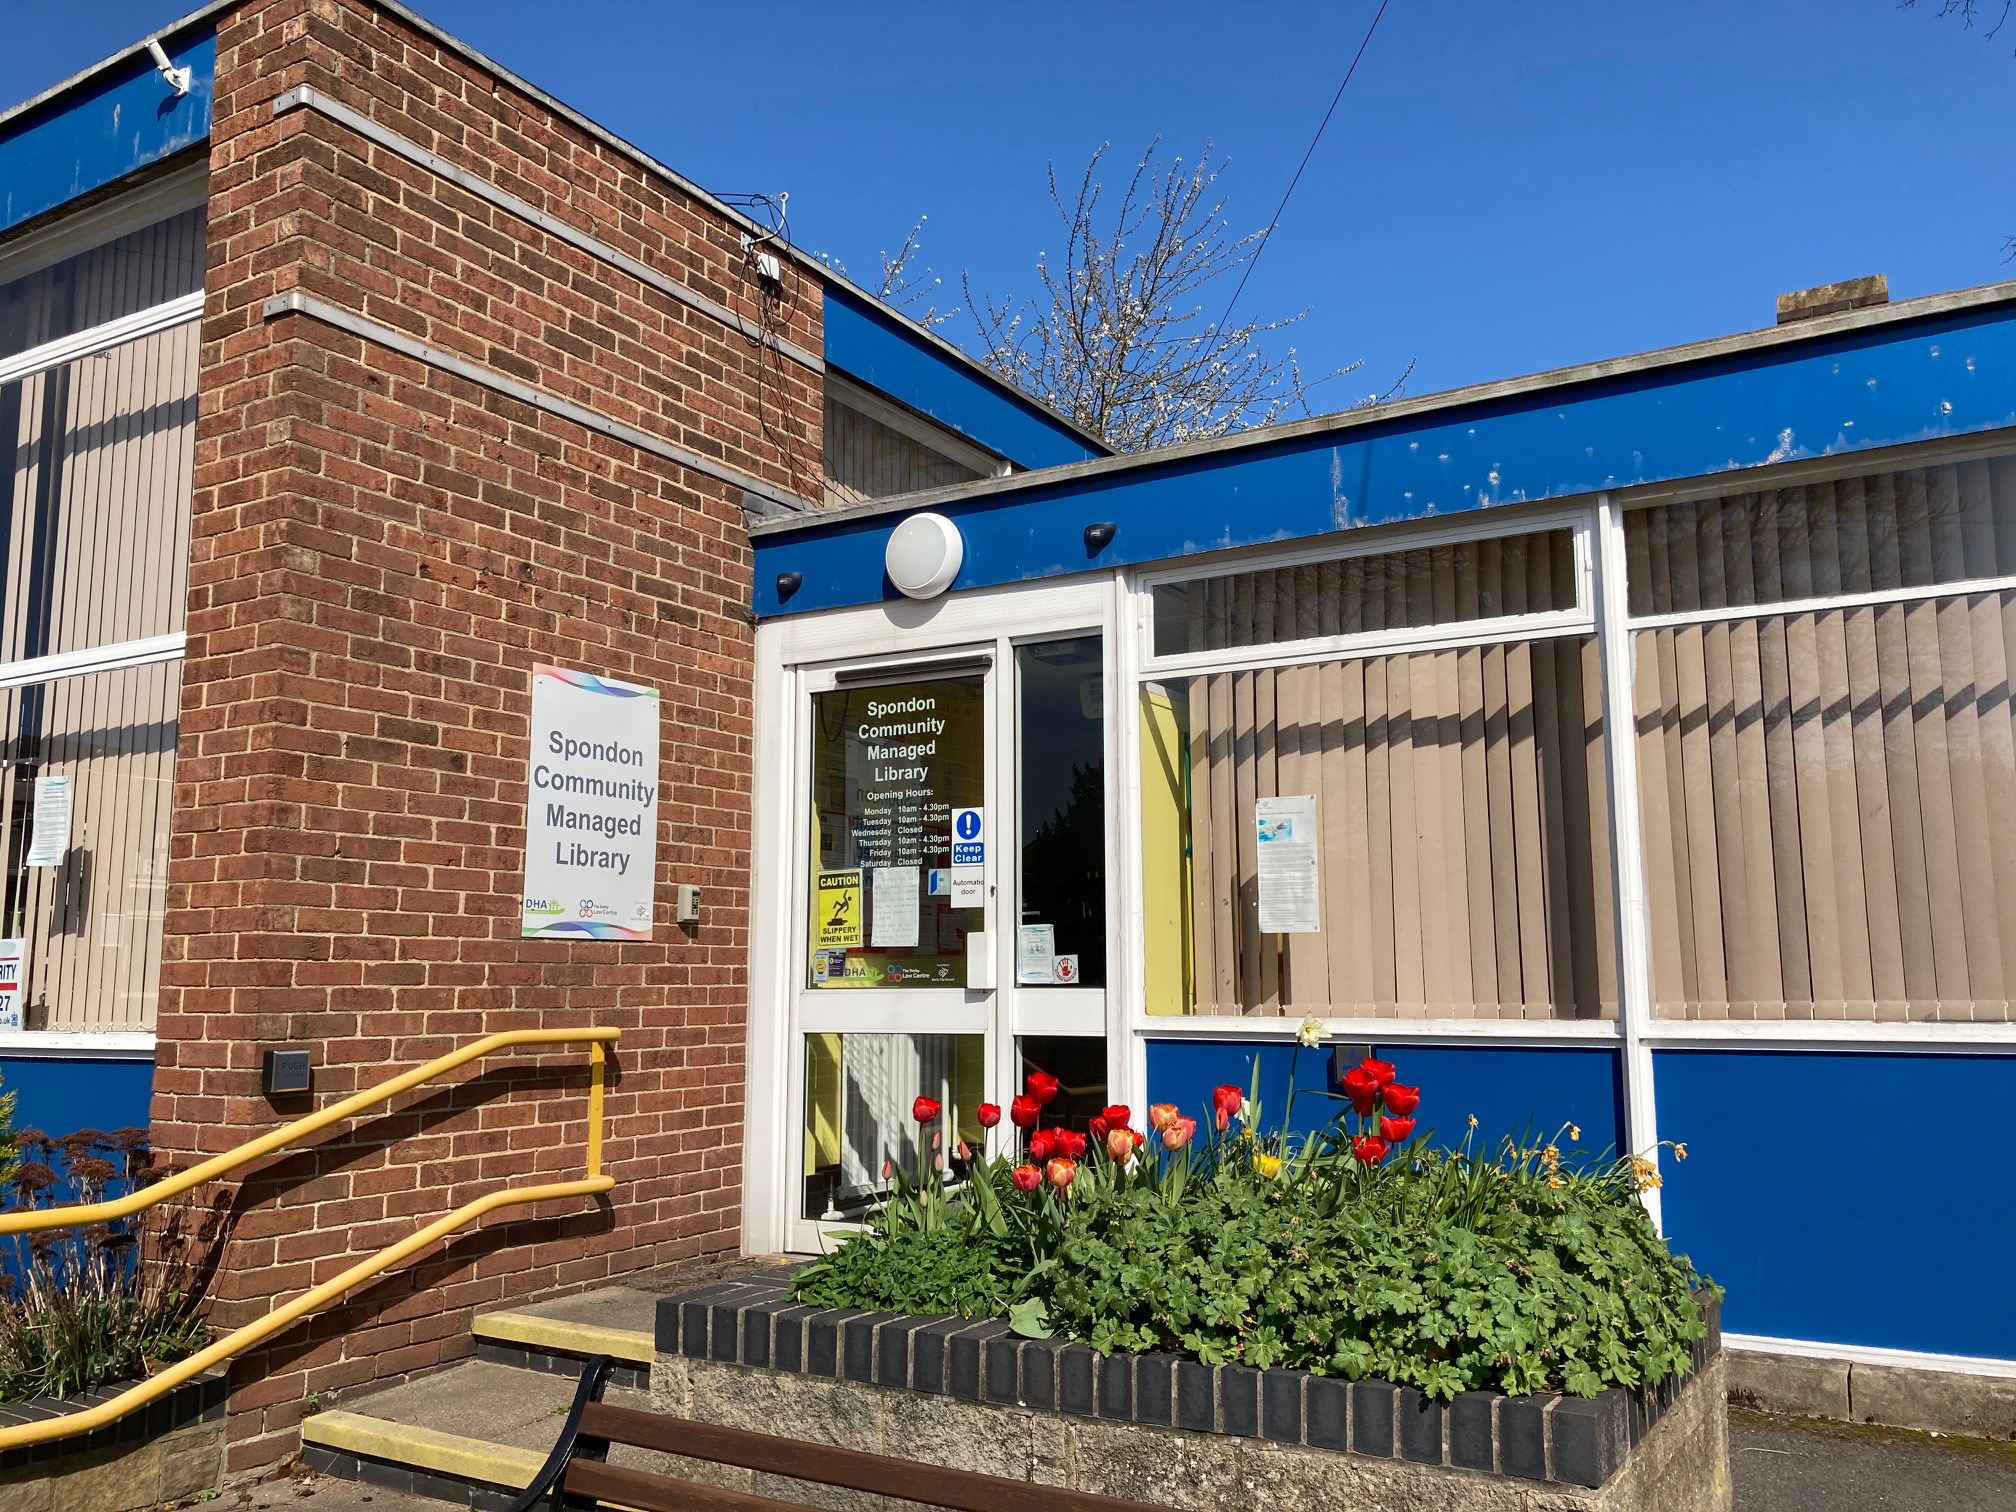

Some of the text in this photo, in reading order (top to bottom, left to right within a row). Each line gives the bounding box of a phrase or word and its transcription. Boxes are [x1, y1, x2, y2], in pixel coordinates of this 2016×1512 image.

[867, 697, 936, 718] Spondon
[858, 717, 946, 739] Community
[549, 730, 643, 767] Spondon
[867, 740, 936, 760] Managed
[874, 766, 929, 782] Library
[534, 765, 655, 808] Community
[867, 789, 934, 801] Opening Hours:
[864, 807, 892, 816] Monday
[922, 803, 950, 812] 4.30pm
[546, 803, 641, 839] Managed
[862, 818, 892, 826] Tuesday
[922, 813, 950, 822] 4.30pm
[851, 826, 923, 837] Wednesday Closed
[859, 838, 892, 847] Thursday
[922, 835, 950, 844] 4.30pm
[869, 849, 892, 857] Friday
[922, 845, 950, 854] 4.30pm
[955, 844, 982, 853] Keep
[556, 841, 631, 876] Library
[860, 857, 923, 869] Saturday Closed
[954, 854, 982, 862] Clear
[820, 875, 859, 887] CAUTION
[525, 898, 548, 909] DHA
[822, 926, 857, 935] SLIPPERY
[820, 934, 859, 943] WHEN WET
[845, 968, 867, 977] DHA
[282, 1062, 306, 1070] PUSH
